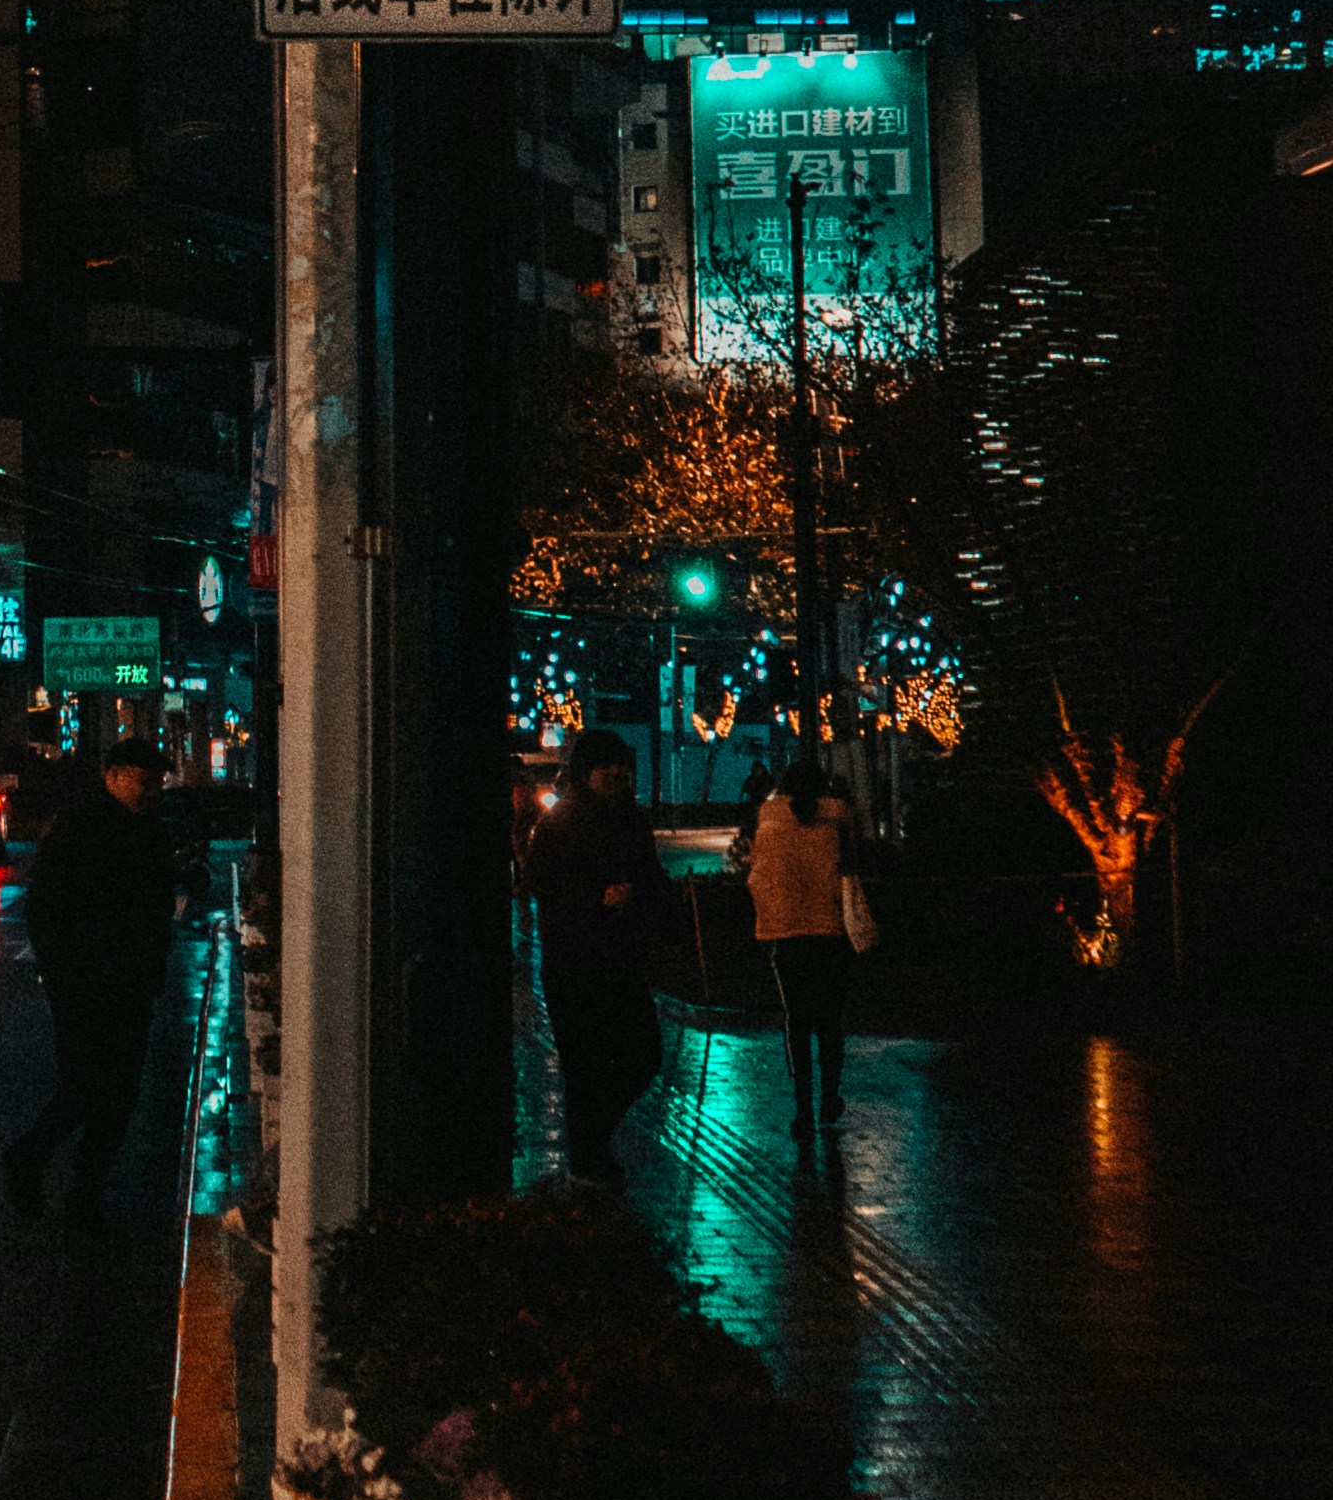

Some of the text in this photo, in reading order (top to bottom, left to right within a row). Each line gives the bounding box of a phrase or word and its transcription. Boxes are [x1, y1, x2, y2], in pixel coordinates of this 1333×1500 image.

[714, 104, 908, 141] 买进口建材到
[716, 148, 911, 199] 喜盈门
[0, 638, 26, 659] 4F
[115, 664, 149, 684] 开放
